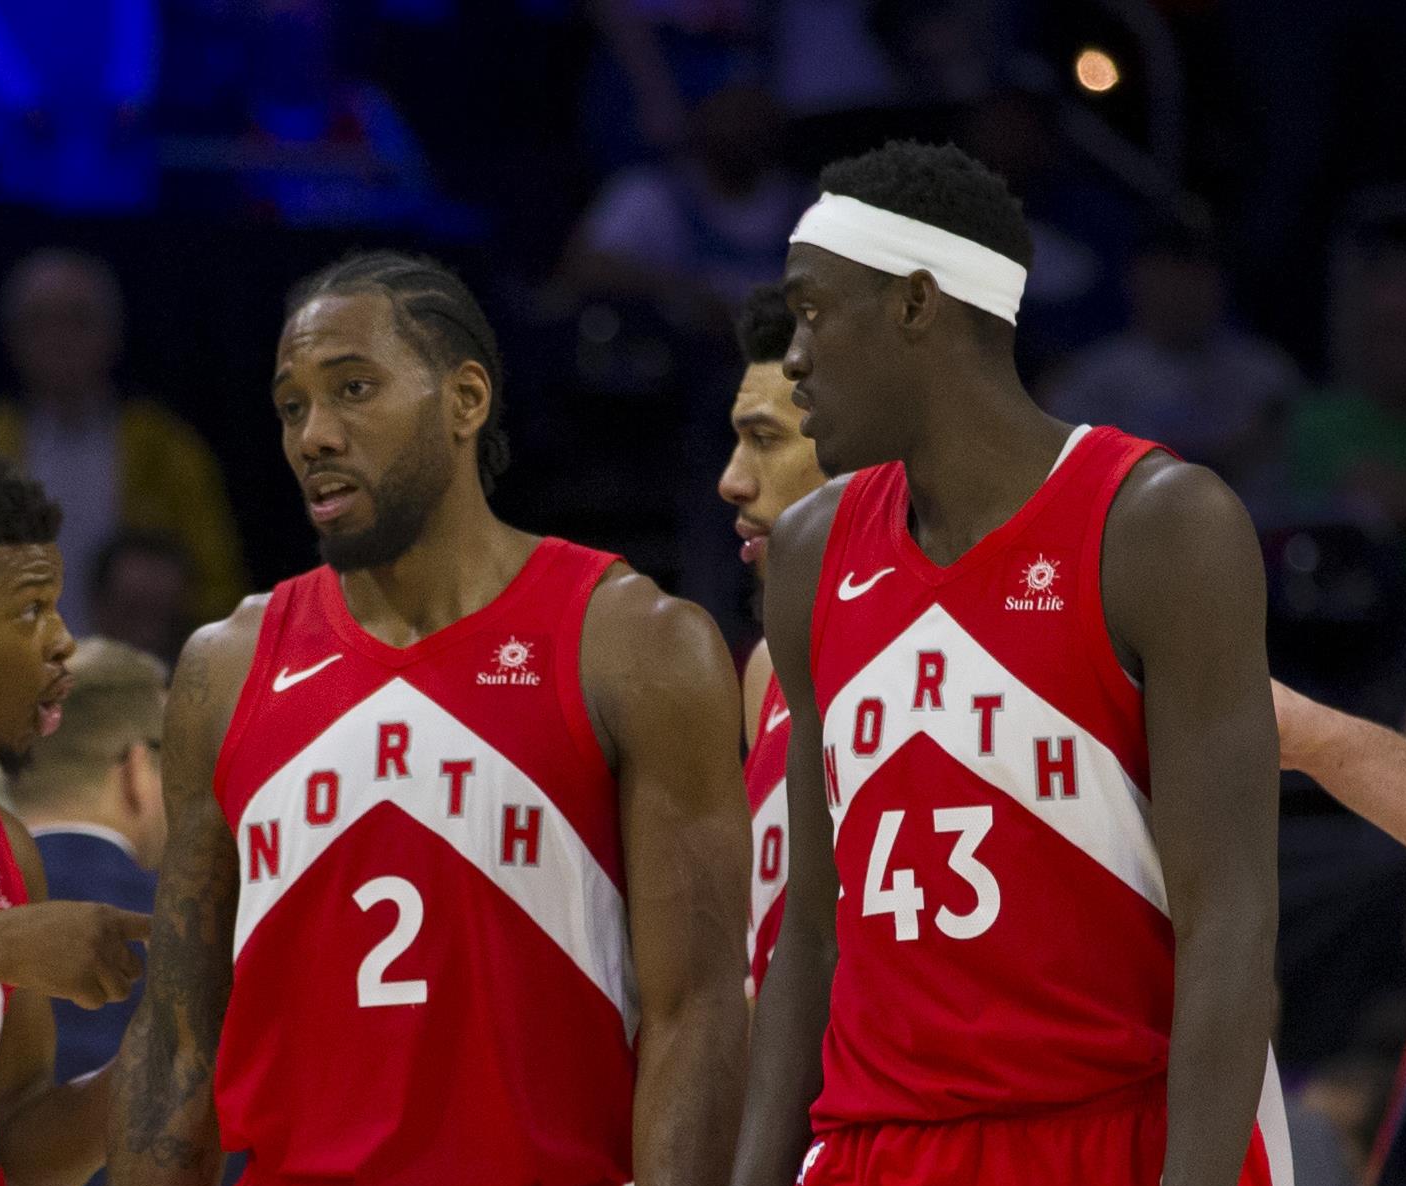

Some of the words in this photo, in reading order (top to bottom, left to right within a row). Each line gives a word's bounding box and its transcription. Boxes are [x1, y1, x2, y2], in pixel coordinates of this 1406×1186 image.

[1004, 596, 1034, 611] Sun
[1037, 596, 1065, 611] Life
[476, 671, 507, 685] Sun
[510, 672, 541, 686] Life
[823, 649, 1079, 809] NORTH
[247, 721, 544, 884] NORTH
[862, 805, 1001, 941] 43
[352, 875, 428, 1008] 2
